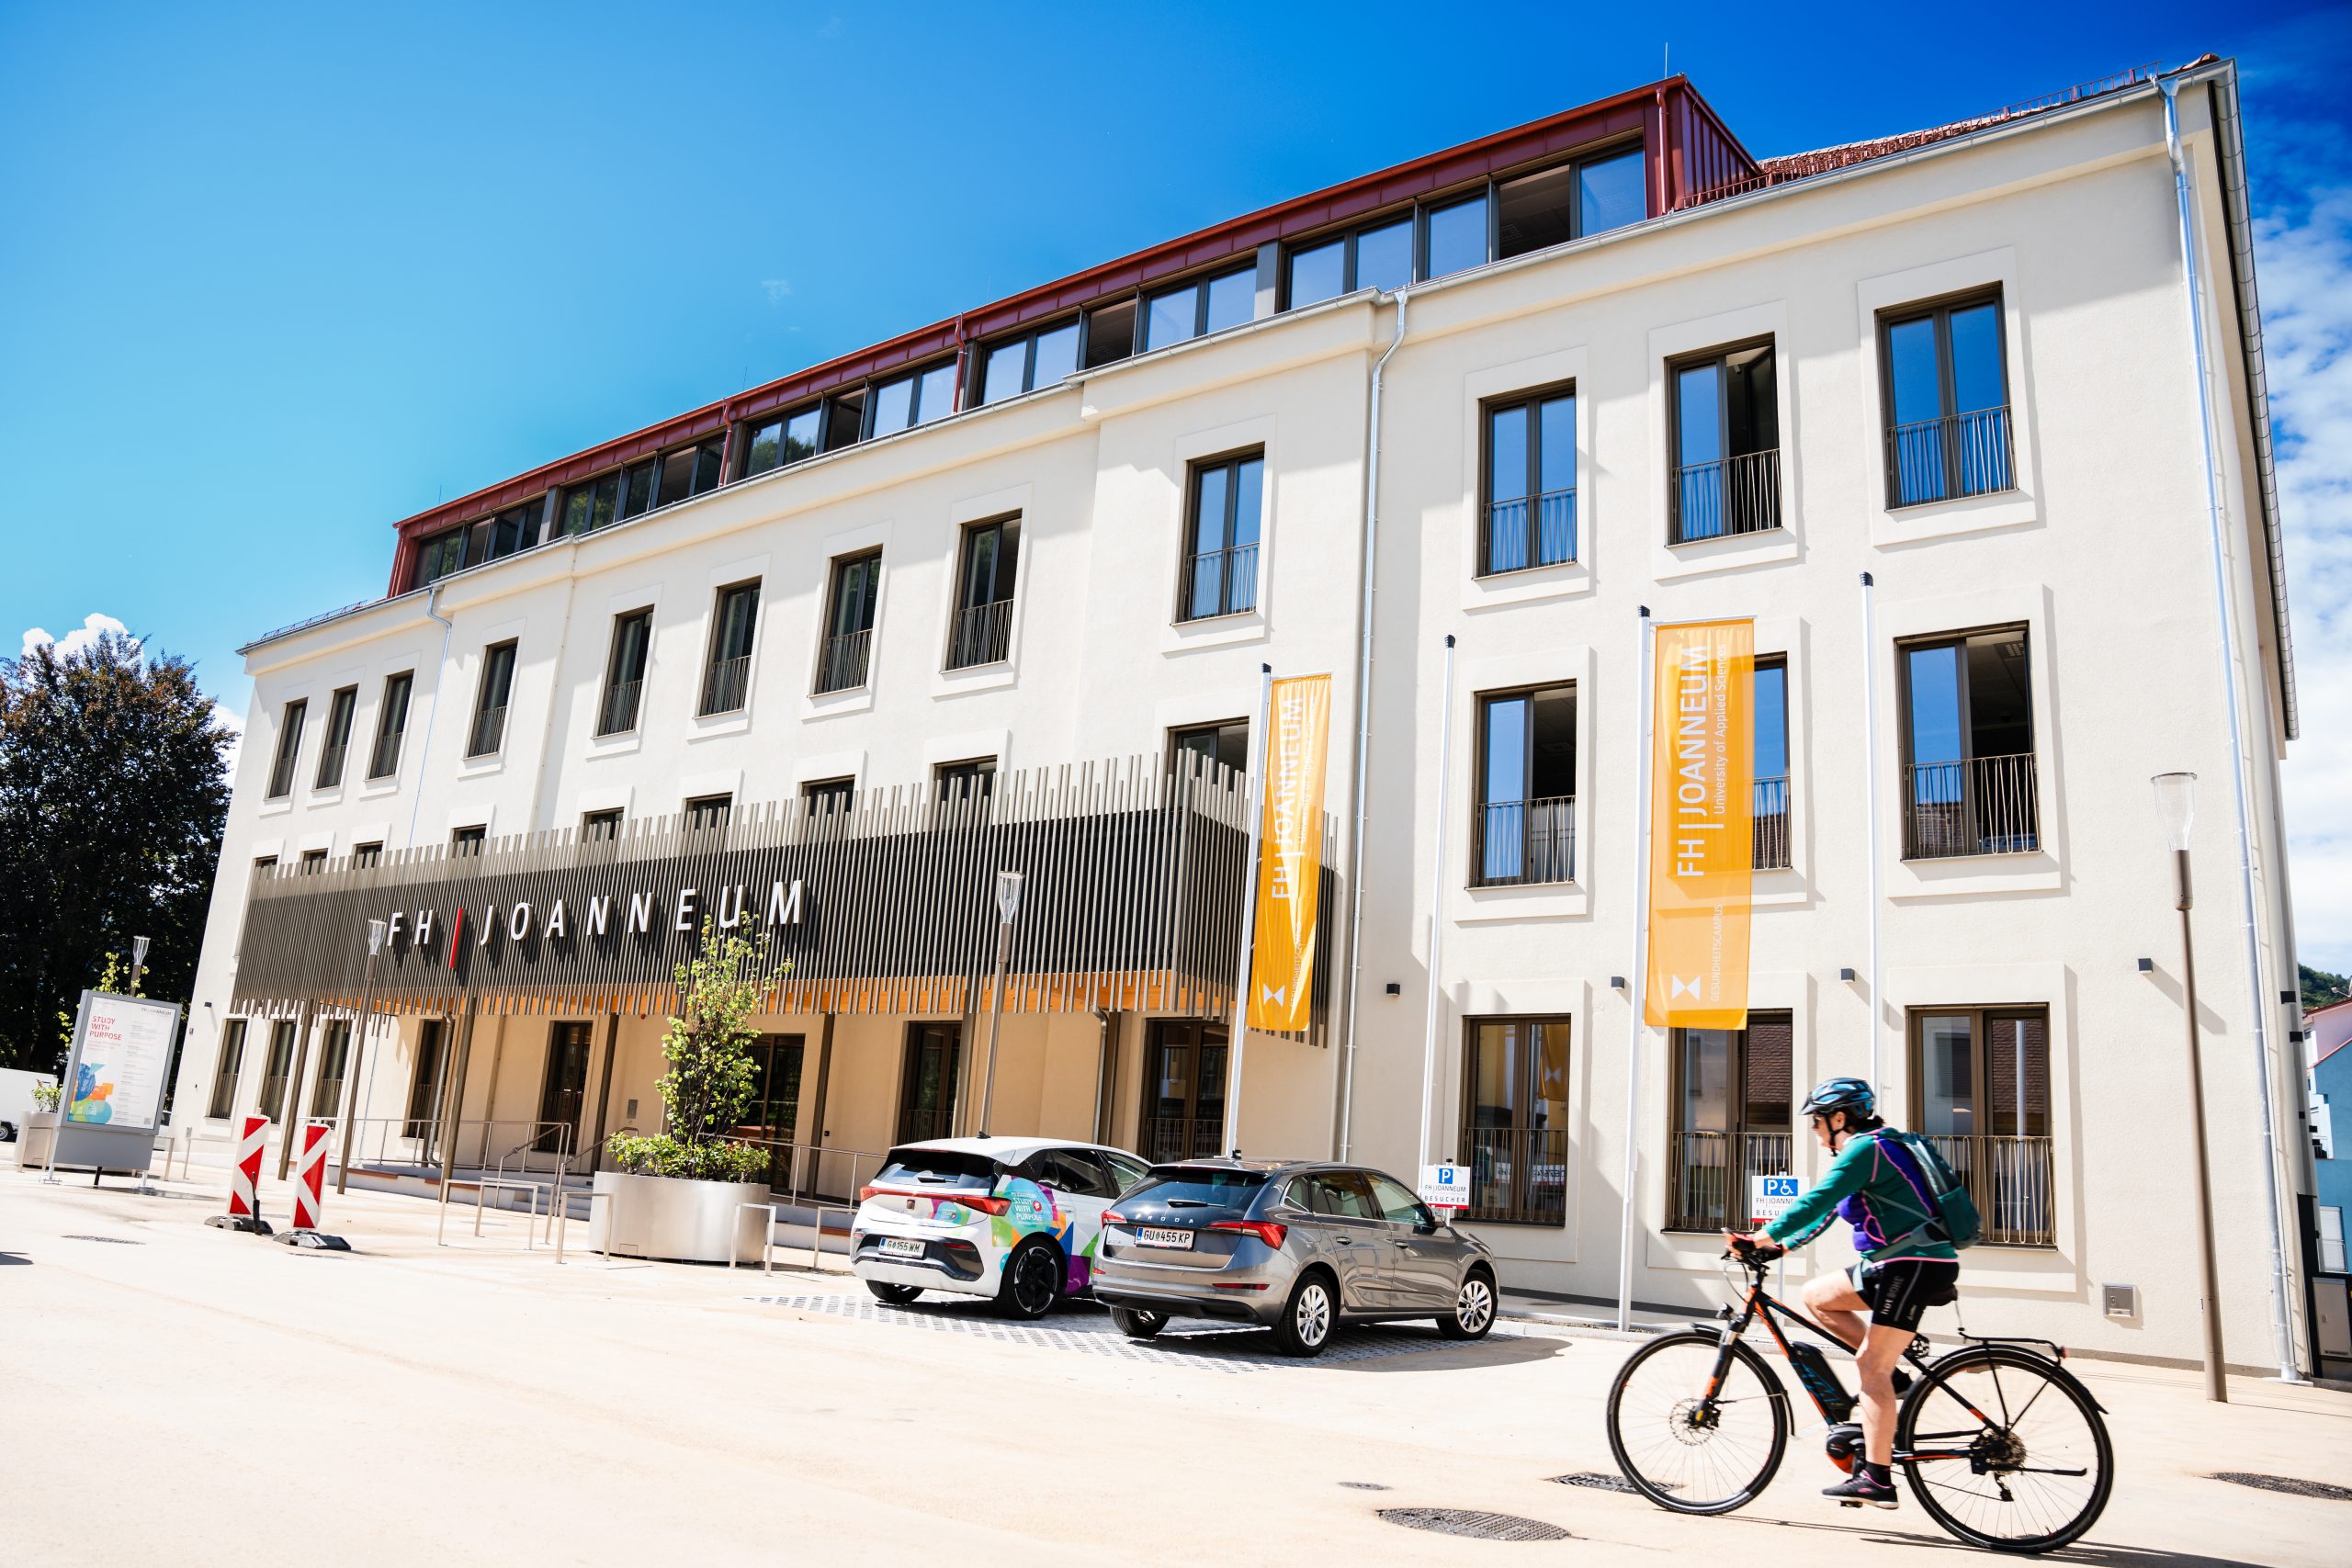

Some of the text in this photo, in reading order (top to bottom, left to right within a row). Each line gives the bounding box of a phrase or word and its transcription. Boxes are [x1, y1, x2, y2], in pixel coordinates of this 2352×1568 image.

[1677, 646, 1708, 877] FH JOANNEUM
[1713, 643, 1728, 815] University of Applied Sciences
[1272, 697, 1304, 899] FH JOANNEUM
[387, 879, 804, 946] FH JOANNEUM
[1711, 903, 1723, 1002] GESUNDHEITSCAMPUS
[89, 1031, 122, 1041] PURPOSE
[92, 1016, 116, 1024] STUDY
[1442, 1168, 1451, 1183] P
[1767, 1179, 1778, 1195] P
